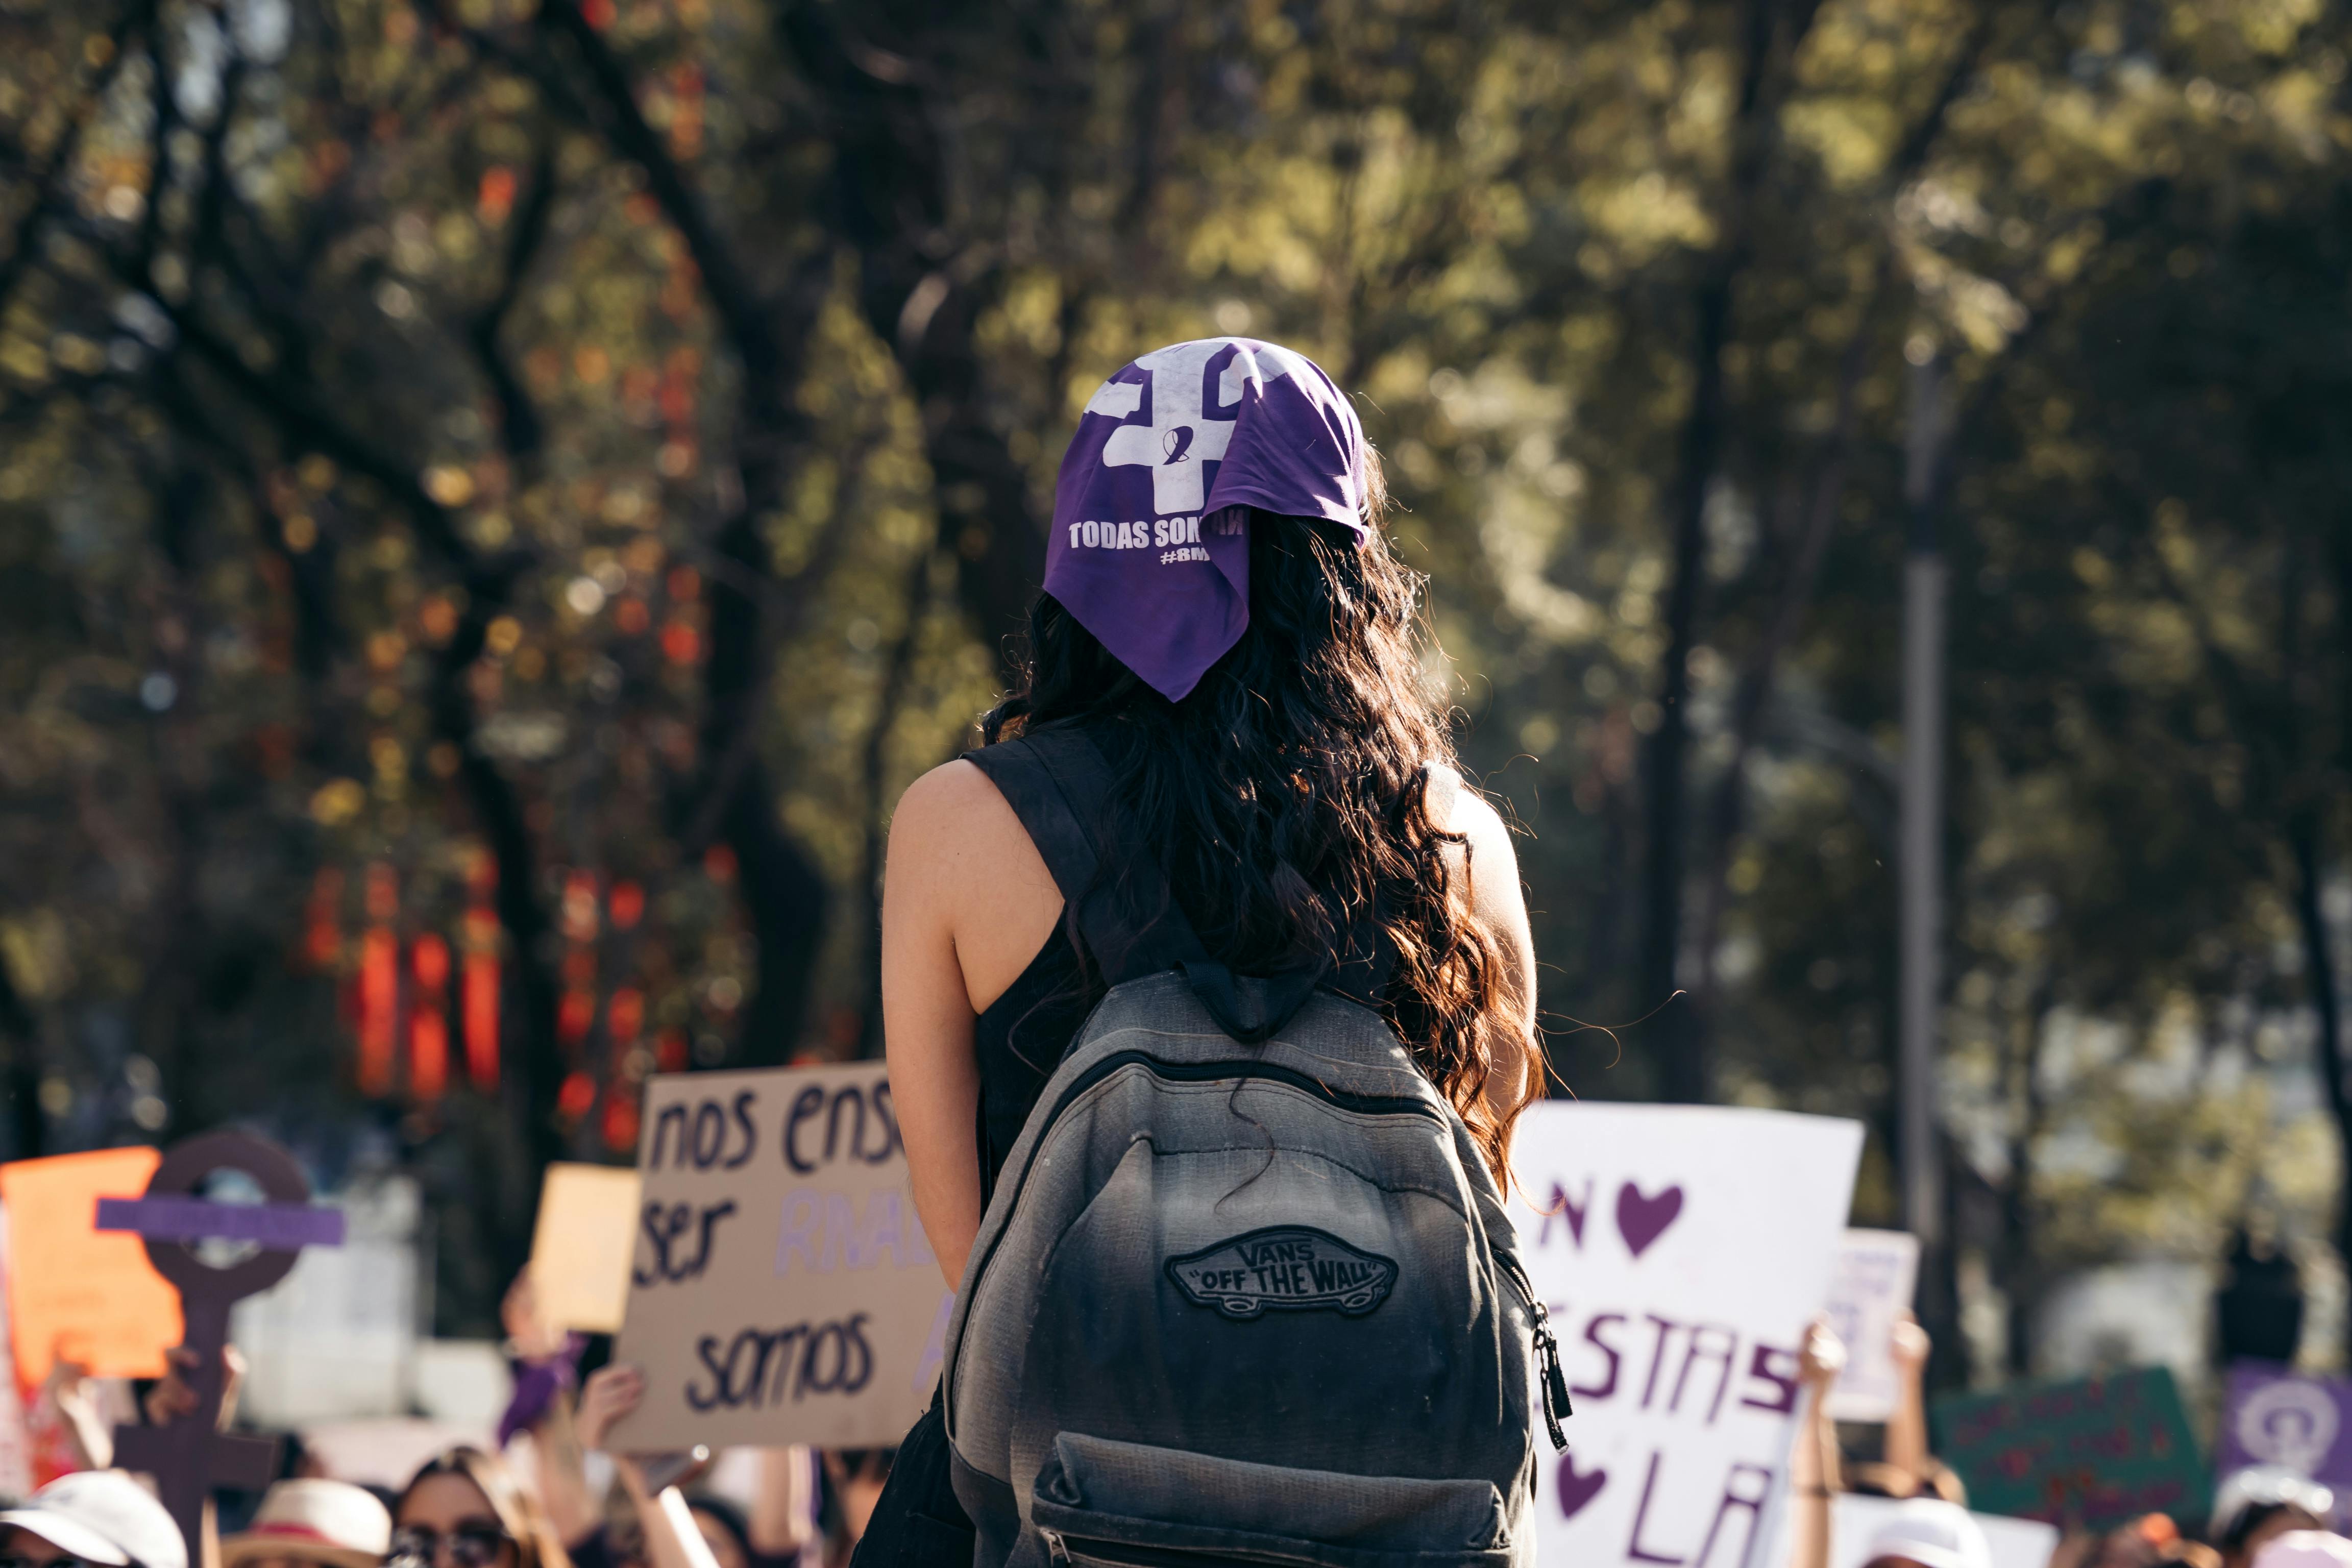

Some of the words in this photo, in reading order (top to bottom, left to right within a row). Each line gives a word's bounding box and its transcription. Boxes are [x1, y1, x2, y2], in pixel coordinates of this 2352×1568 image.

[1069, 521, 1149, 550] TODAS
[1160, 547, 1210, 565] #8M
[649, 1087, 760, 1172] nos
[633, 1196, 739, 1287] ser
[1235, 1238, 1315, 1267] VANS
[1251, 1263, 1309, 1294] THE
[685, 1312, 877, 1412] somos
[1626, 1451, 1773, 1568] LA
